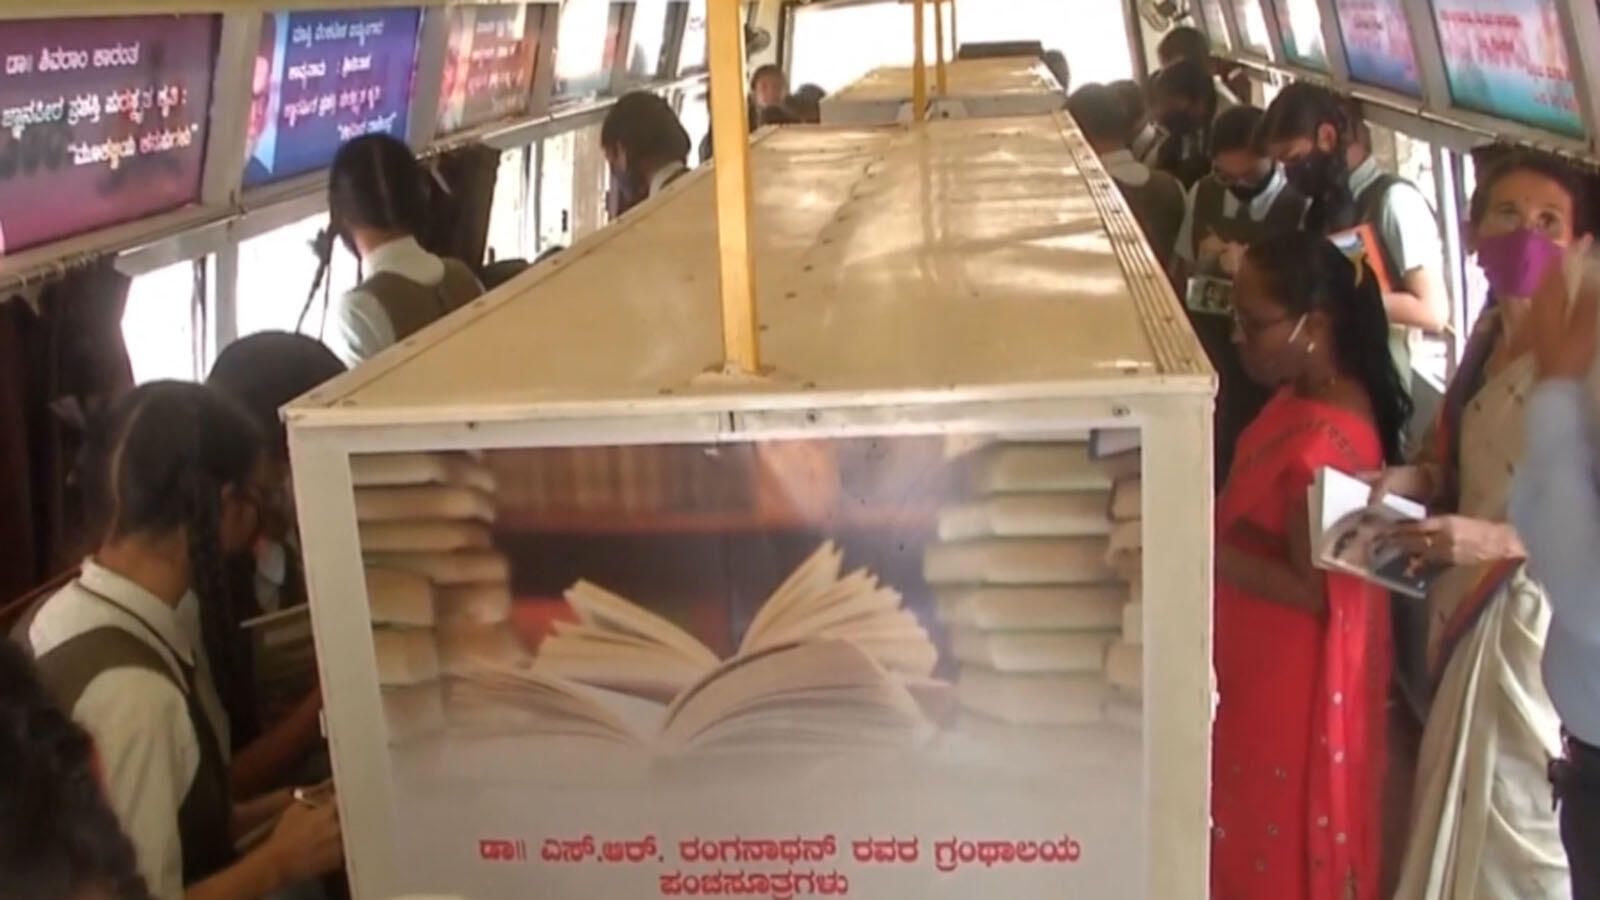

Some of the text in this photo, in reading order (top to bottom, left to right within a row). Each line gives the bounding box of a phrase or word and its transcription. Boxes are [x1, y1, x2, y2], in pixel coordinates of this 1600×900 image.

[679, 834, 837, 864] ರಂಗನಾಥನ್
[852, 836, 919, 862] ರವರ
[934, 834, 1081, 872] ಗ್ರಂಥಾಲಯ
[659, 868, 849, 900] ಪಂಚಸೂತ್ರಗಳು
